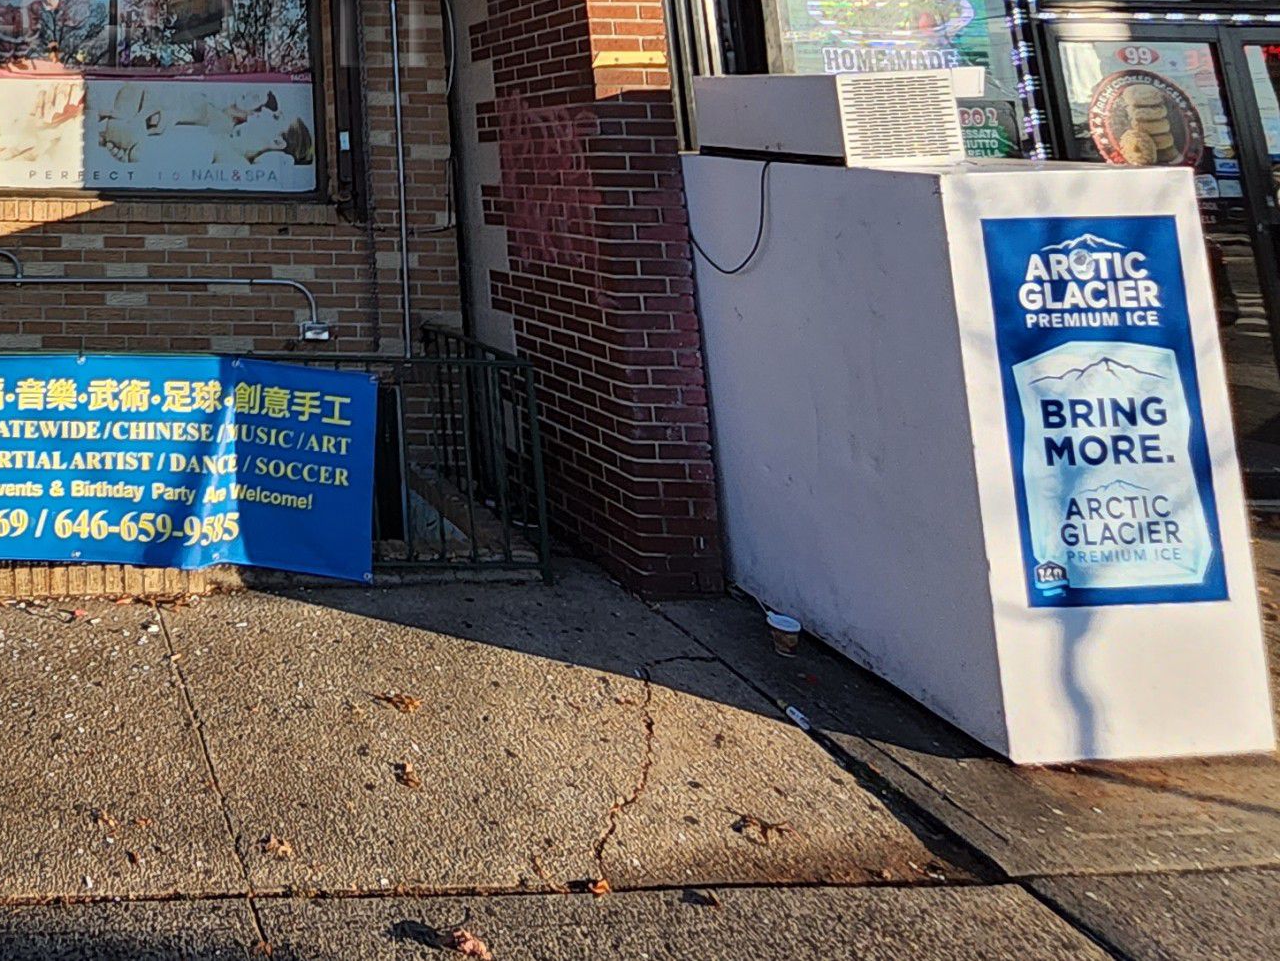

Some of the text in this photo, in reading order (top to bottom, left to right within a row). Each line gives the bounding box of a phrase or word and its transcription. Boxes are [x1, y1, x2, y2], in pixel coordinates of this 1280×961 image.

[29, 169, 134, 181] PERFECT
[1024, 248, 1149, 282] ARCTIC
[1018, 280, 1162, 311] GLACIER
[1026, 310, 1160, 329] PREMIUM ICE
[1040, 396, 1168, 430] BRING
[1043, 434, 1175, 467] MORE.
[69, 451, 153, 471] ARTIST
[169, 453, 238, 475] DANCE
[254, 456, 350, 486] SOCCER
[49, 480, 65, 497] &
[71, 480, 145, 503] Birthday
[151, 482, 195, 504] Party
[229, 483, 314, 510] Welcome!
[1064, 494, 1172, 521] ARCTIC
[1060, 520, 1183, 548] GLACIER
[1066, 548, 1181, 563] PREMIUM ICE
